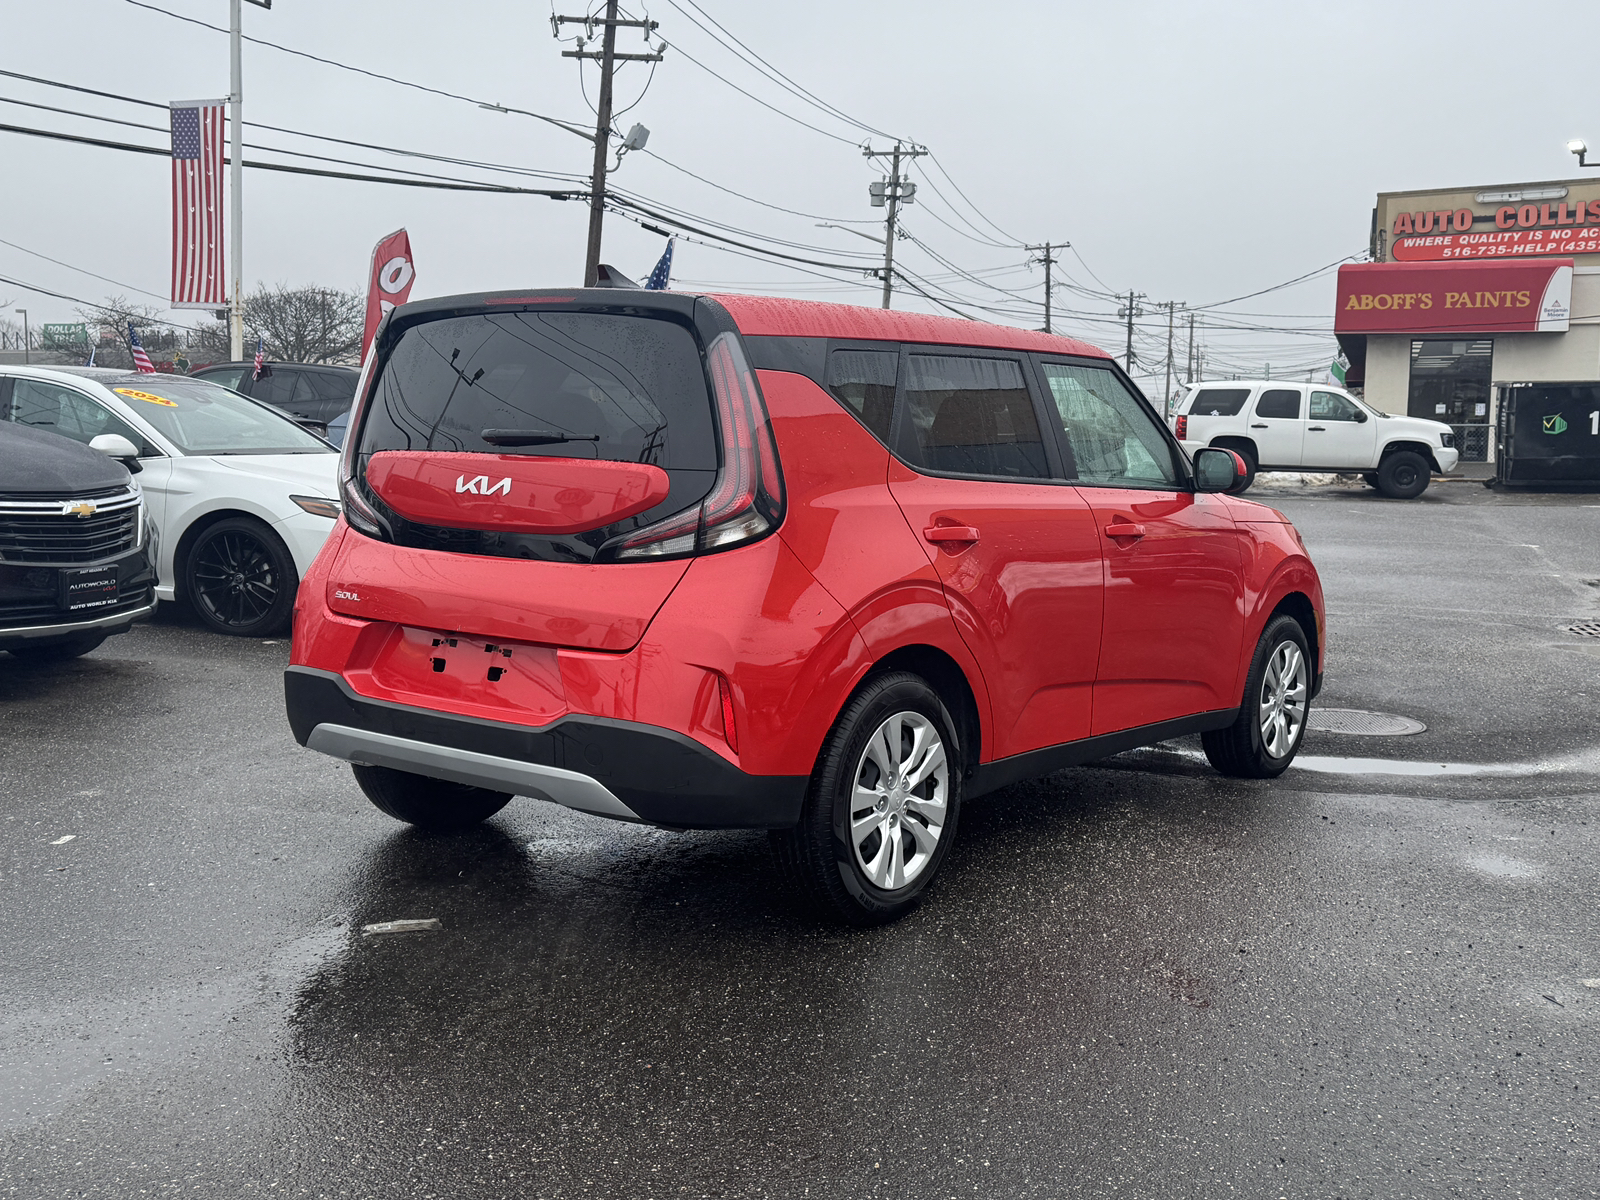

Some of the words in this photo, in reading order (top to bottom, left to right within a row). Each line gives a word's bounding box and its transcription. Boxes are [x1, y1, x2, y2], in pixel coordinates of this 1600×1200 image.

[1393, 209, 1473, 234] AUTO
[1403, 236, 1453, 248] WHERE
[1459, 232, 1522, 244] QUALITY
[1528, 231, 1543, 240] IS
[1551, 229, 1572, 239] NO
[1442, 243, 1557, 257] 516-735-HELP
[1560, 240, 1600, 253] (435
[1345, 293, 1433, 310] ABOFF'S
[1444, 290, 1531, 309] PAINTS
[47, 325, 82, 334] DOLLAR
[455, 474, 512, 496] KIA
[70, 579, 116, 590] AUTOWORLD
[335, 590, 361, 601] SOUL
